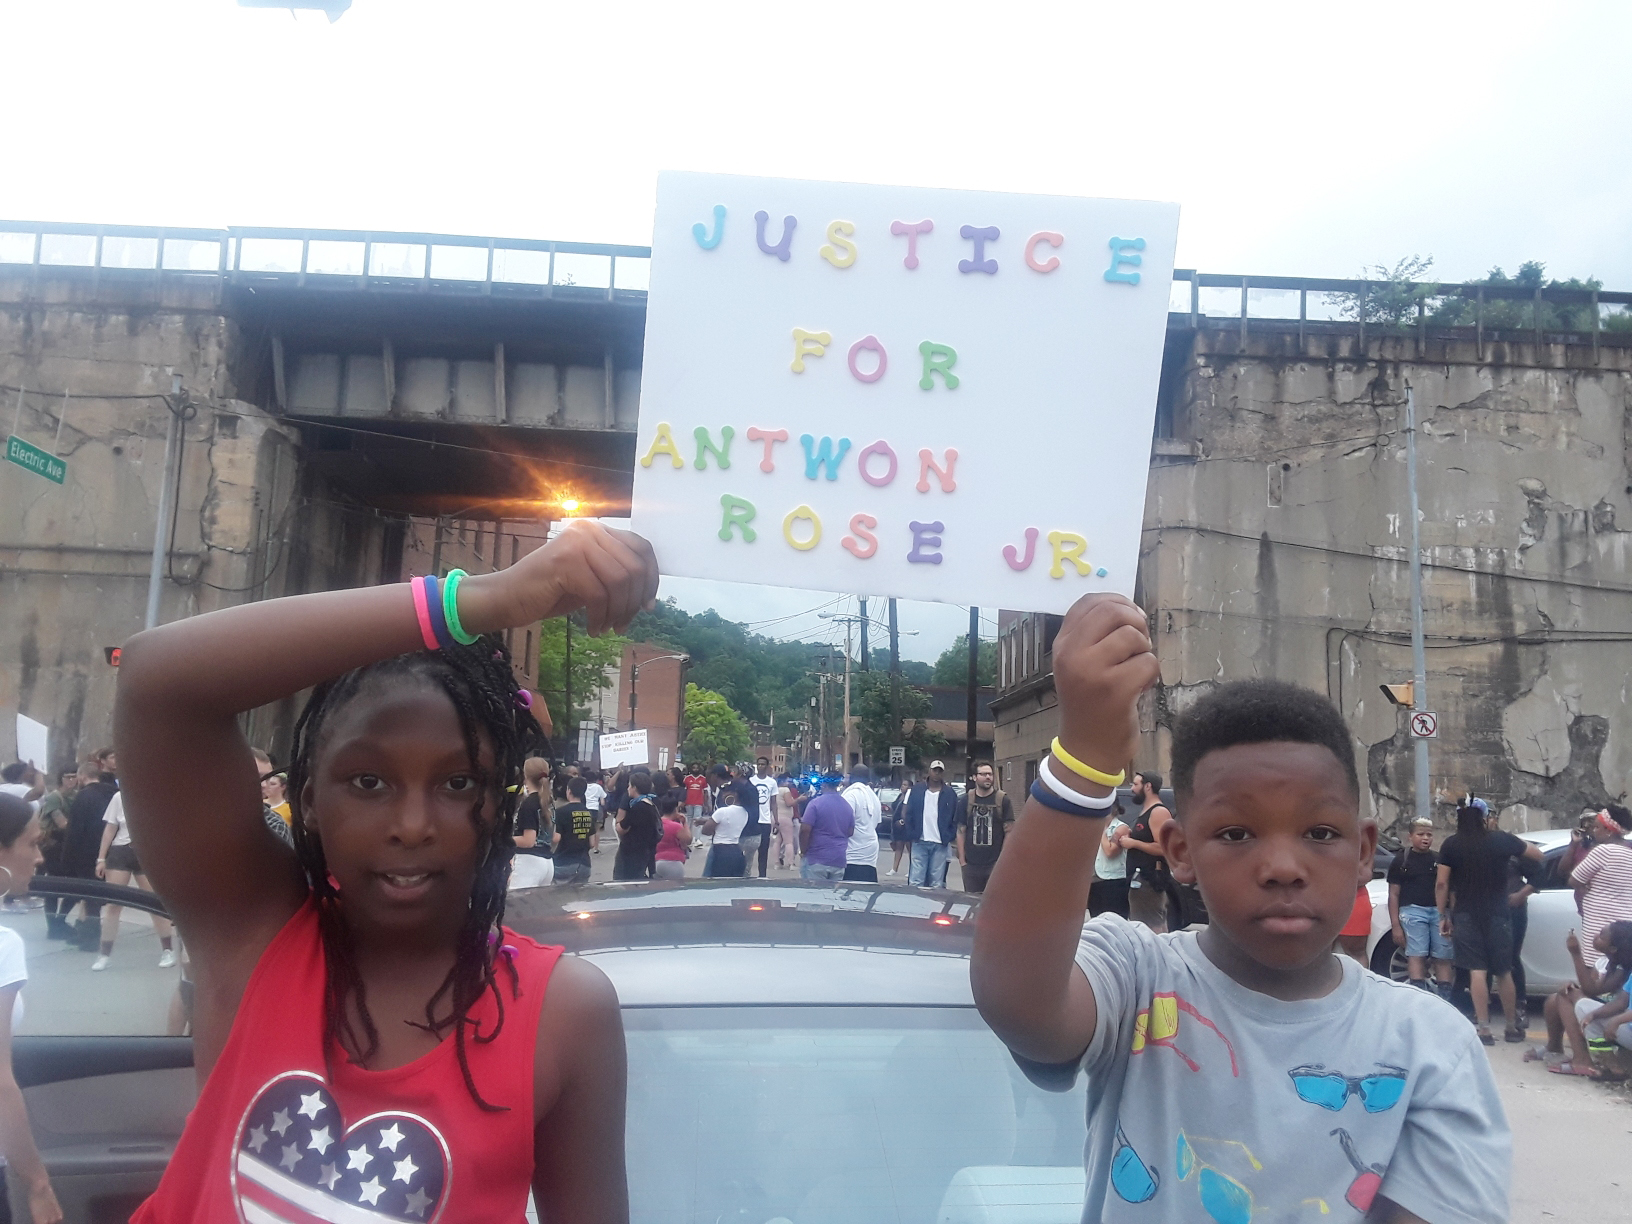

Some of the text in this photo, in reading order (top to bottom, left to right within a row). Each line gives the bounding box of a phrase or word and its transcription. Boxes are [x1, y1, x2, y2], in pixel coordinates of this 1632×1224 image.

[691, 203, 1147, 286] JUSTICE
[791, 327, 960, 391] FOR
[10, 441, 62, 479] Electric Ave
[640, 422, 960, 494] ANTWON
[717, 493, 1109, 580] ROSE JR.
[891, 756, 903, 764] 25
